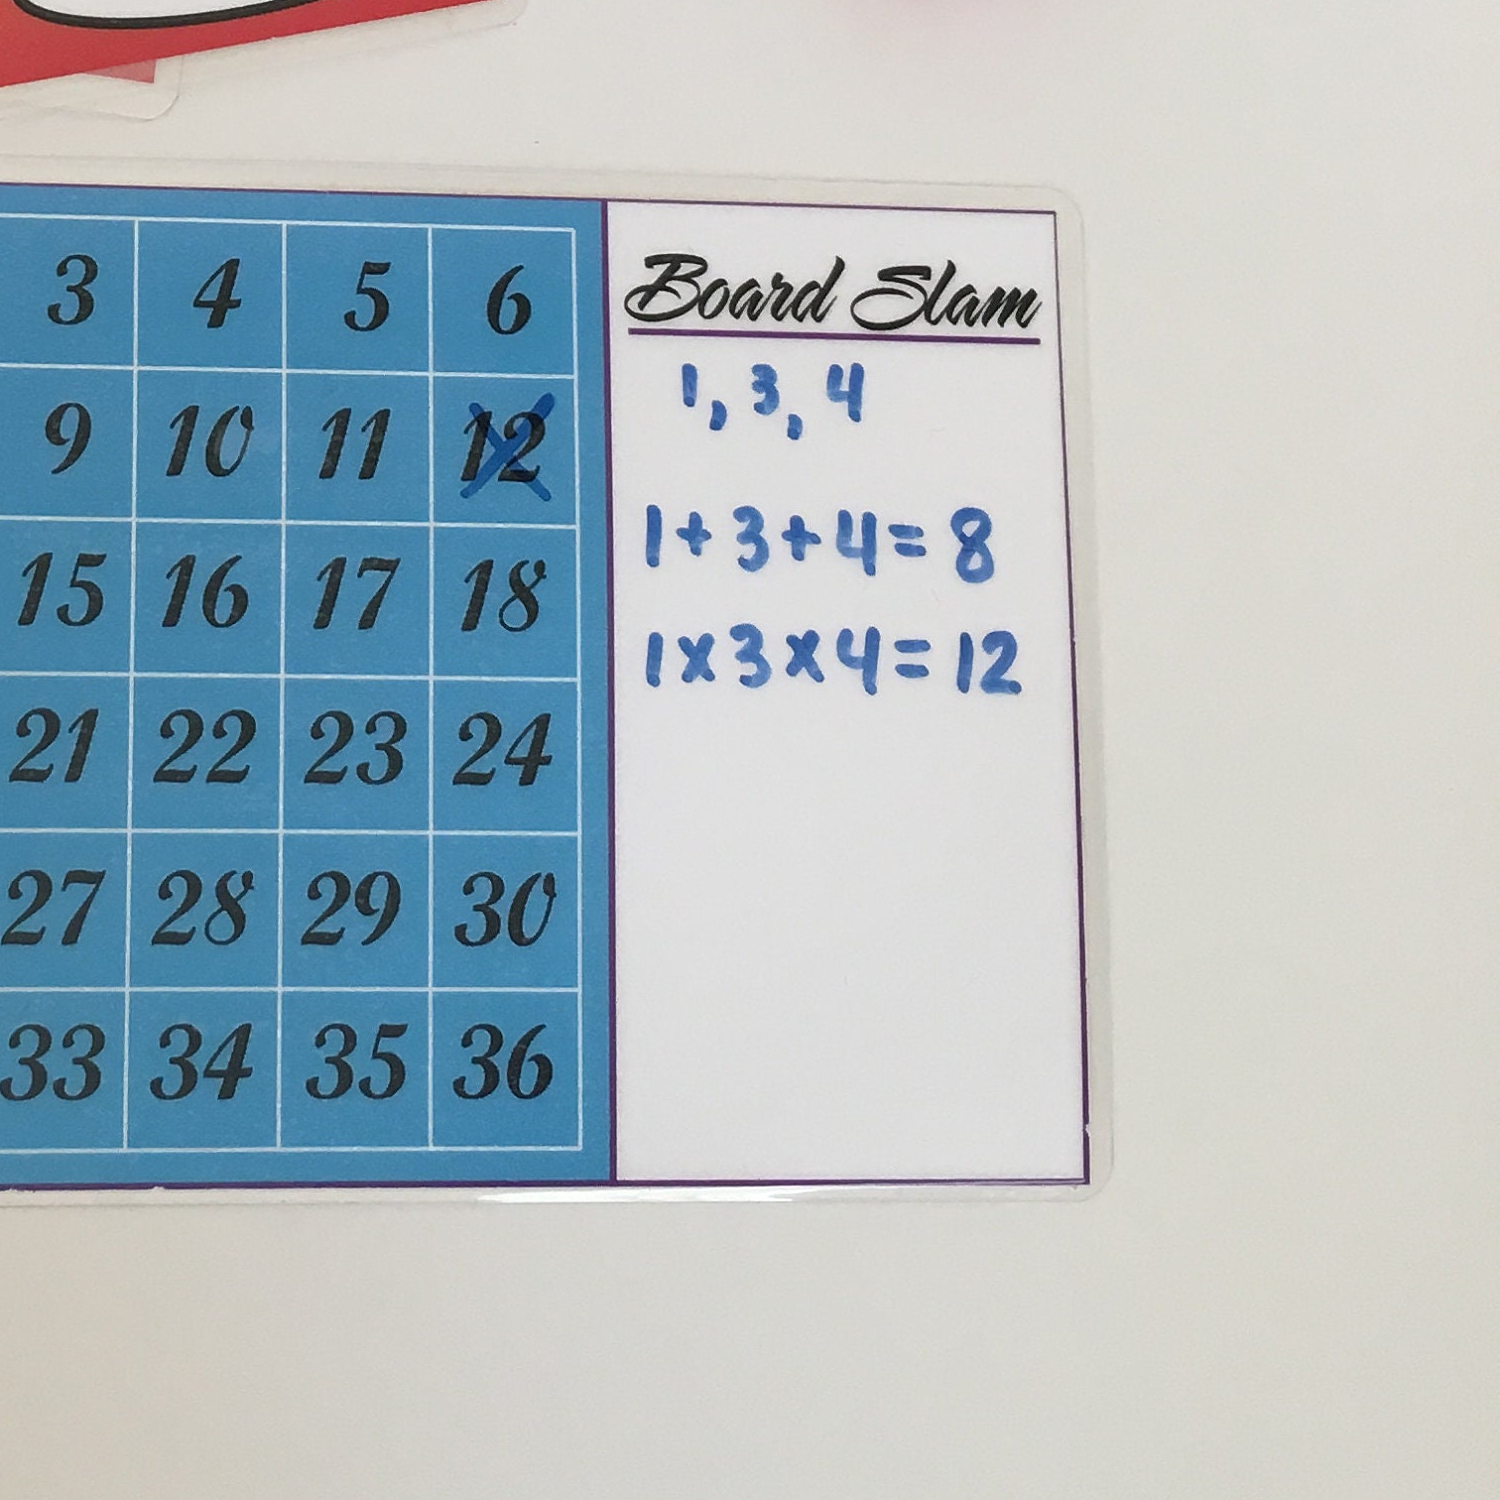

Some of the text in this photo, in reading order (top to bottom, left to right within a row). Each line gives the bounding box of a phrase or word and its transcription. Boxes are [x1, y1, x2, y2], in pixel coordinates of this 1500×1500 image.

[48, 255, 98, 325] 3
[193, 259, 241, 328] 4
[344, 262, 390, 331] 5
[487, 265, 532, 334] 6
[624, 254, 1041, 332] Board Slam
[45, 403, 91, 474] 9
[166, 405, 254, 477] 10
[319, 408, 390, 480] 11
[461, 411, 546, 483] 12
[17, 553, 106, 626] 15
[162, 555, 248, 628] 16
[314, 557, 400, 630] 17
[462, 560, 546, 632] 18
[9, 708, 98, 782] 21
[153, 710, 256, 783] 22
[304, 711, 406, 785] 23
[453, 712, 552, 786] 24
[1, 870, 106, 945] 27
[152, 870, 254, 945] 28
[301, 871, 401, 945] 29
[455, 872, 556, 946] 30
[0, 1024, 105, 1101] 33
[150, 1024, 252, 1100] 34
[306, 1024, 407, 1099] 35
[453, 1024, 553, 1099] 36
